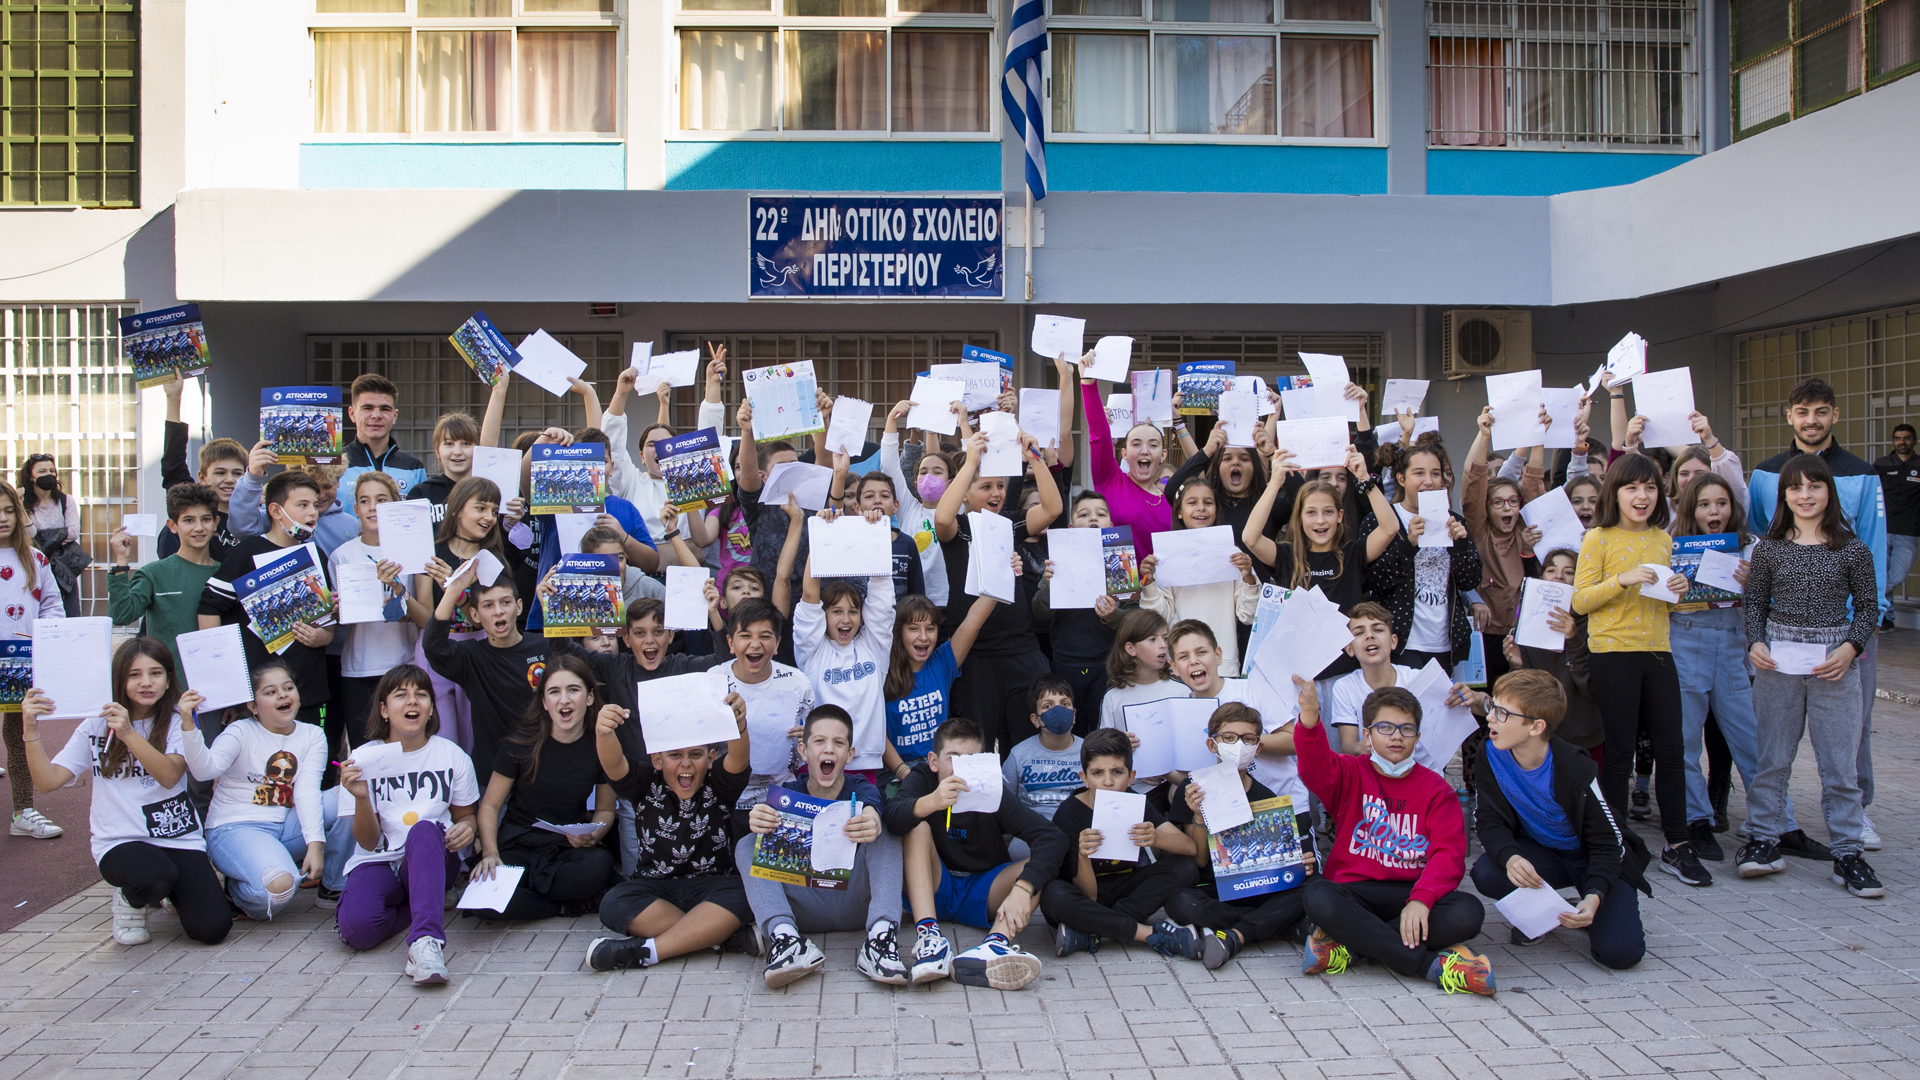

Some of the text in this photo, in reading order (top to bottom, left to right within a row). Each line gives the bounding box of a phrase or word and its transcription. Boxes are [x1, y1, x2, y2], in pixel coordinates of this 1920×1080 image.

[801, 207, 907, 242] ΔΗΜΟΤΙΚΟ
[912, 207, 998, 242] ΣΧΟΛΕΙΟ
[813, 253, 942, 287] ΠΕΡΙΣΤΕΡΙΟΥ
[145, 311, 186, 325] ATROMITOS
[487, 328, 512, 356] ATROMITOS
[979, 351, 1007, 364] ATROMITOS
[675, 435, 708, 449] ATROMITOS
[1683, 539, 1726, 549] ATROMITOS
[258, 558, 298, 582] ATROMITOS
[565, 560, 606, 568] ATROMITOS
[898, 689, 943, 713] ΑΣΤΕΡΙ
[902, 703, 943, 725] ΑΣΤΕΡΙ
[910, 722, 927, 733] ΑΠΟ
[151, 800, 189, 823] BACK
[162, 799, 179, 809] KICK
[1396, 798, 1408, 811] OF
[150, 814, 194, 838] RELAX
[655, 828, 677, 841] adidas
[1233, 875, 1280, 891] ATROMITOS
